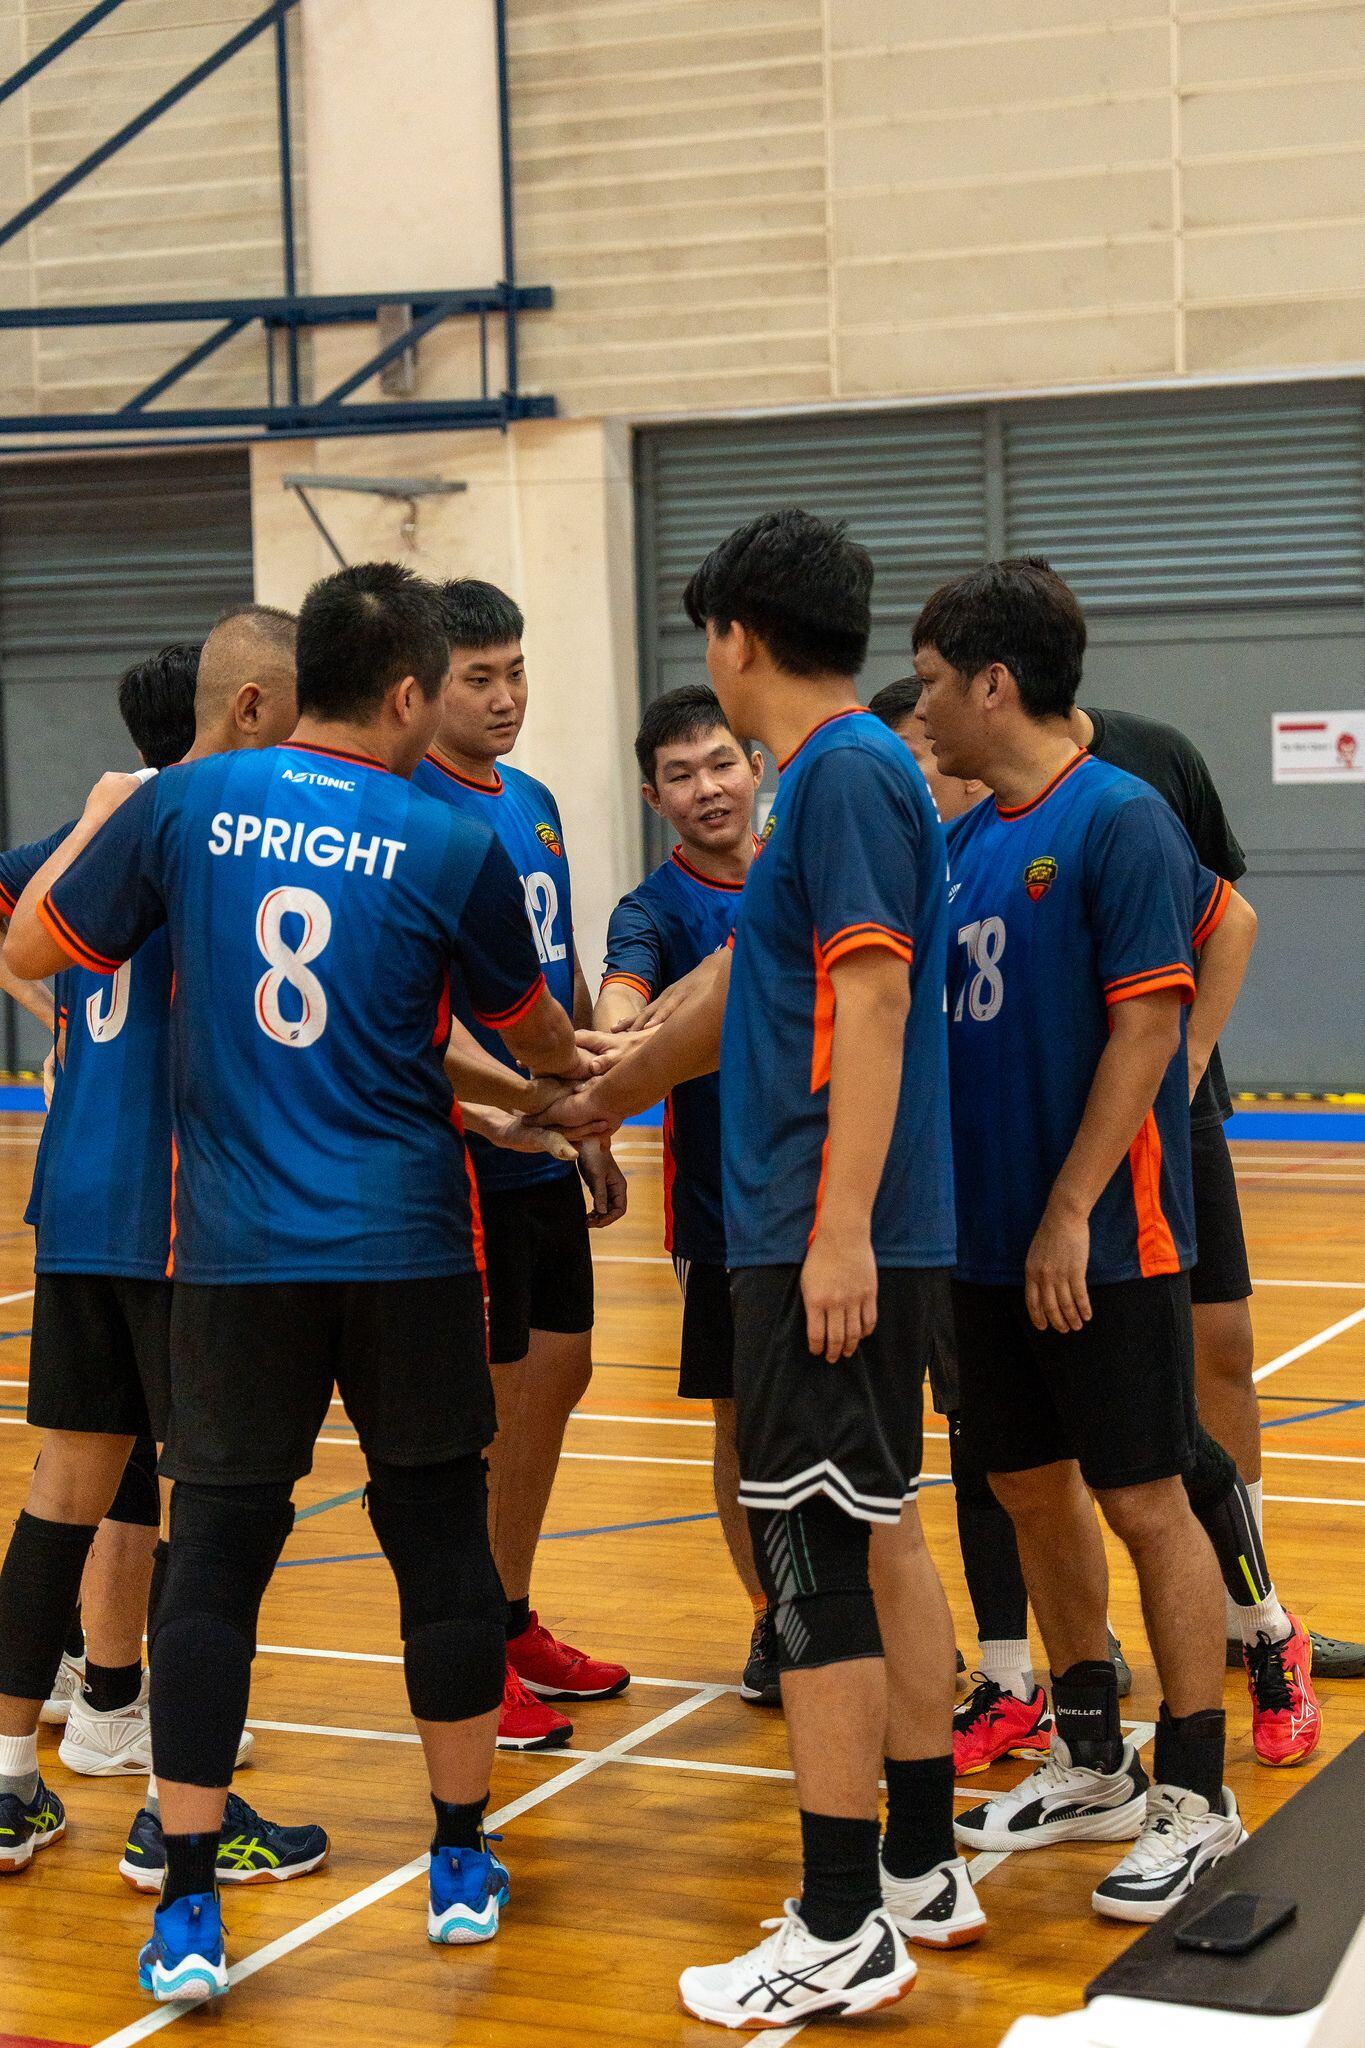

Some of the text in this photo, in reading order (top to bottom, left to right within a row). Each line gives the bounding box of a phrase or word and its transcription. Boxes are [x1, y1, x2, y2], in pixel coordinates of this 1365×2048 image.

[208, 812, 406, 880] SPRIGHT
[519, 871, 567, 964] 12
[254, 886, 332, 1048] 8
[1059, 1707, 1102, 1715] MUELLER
